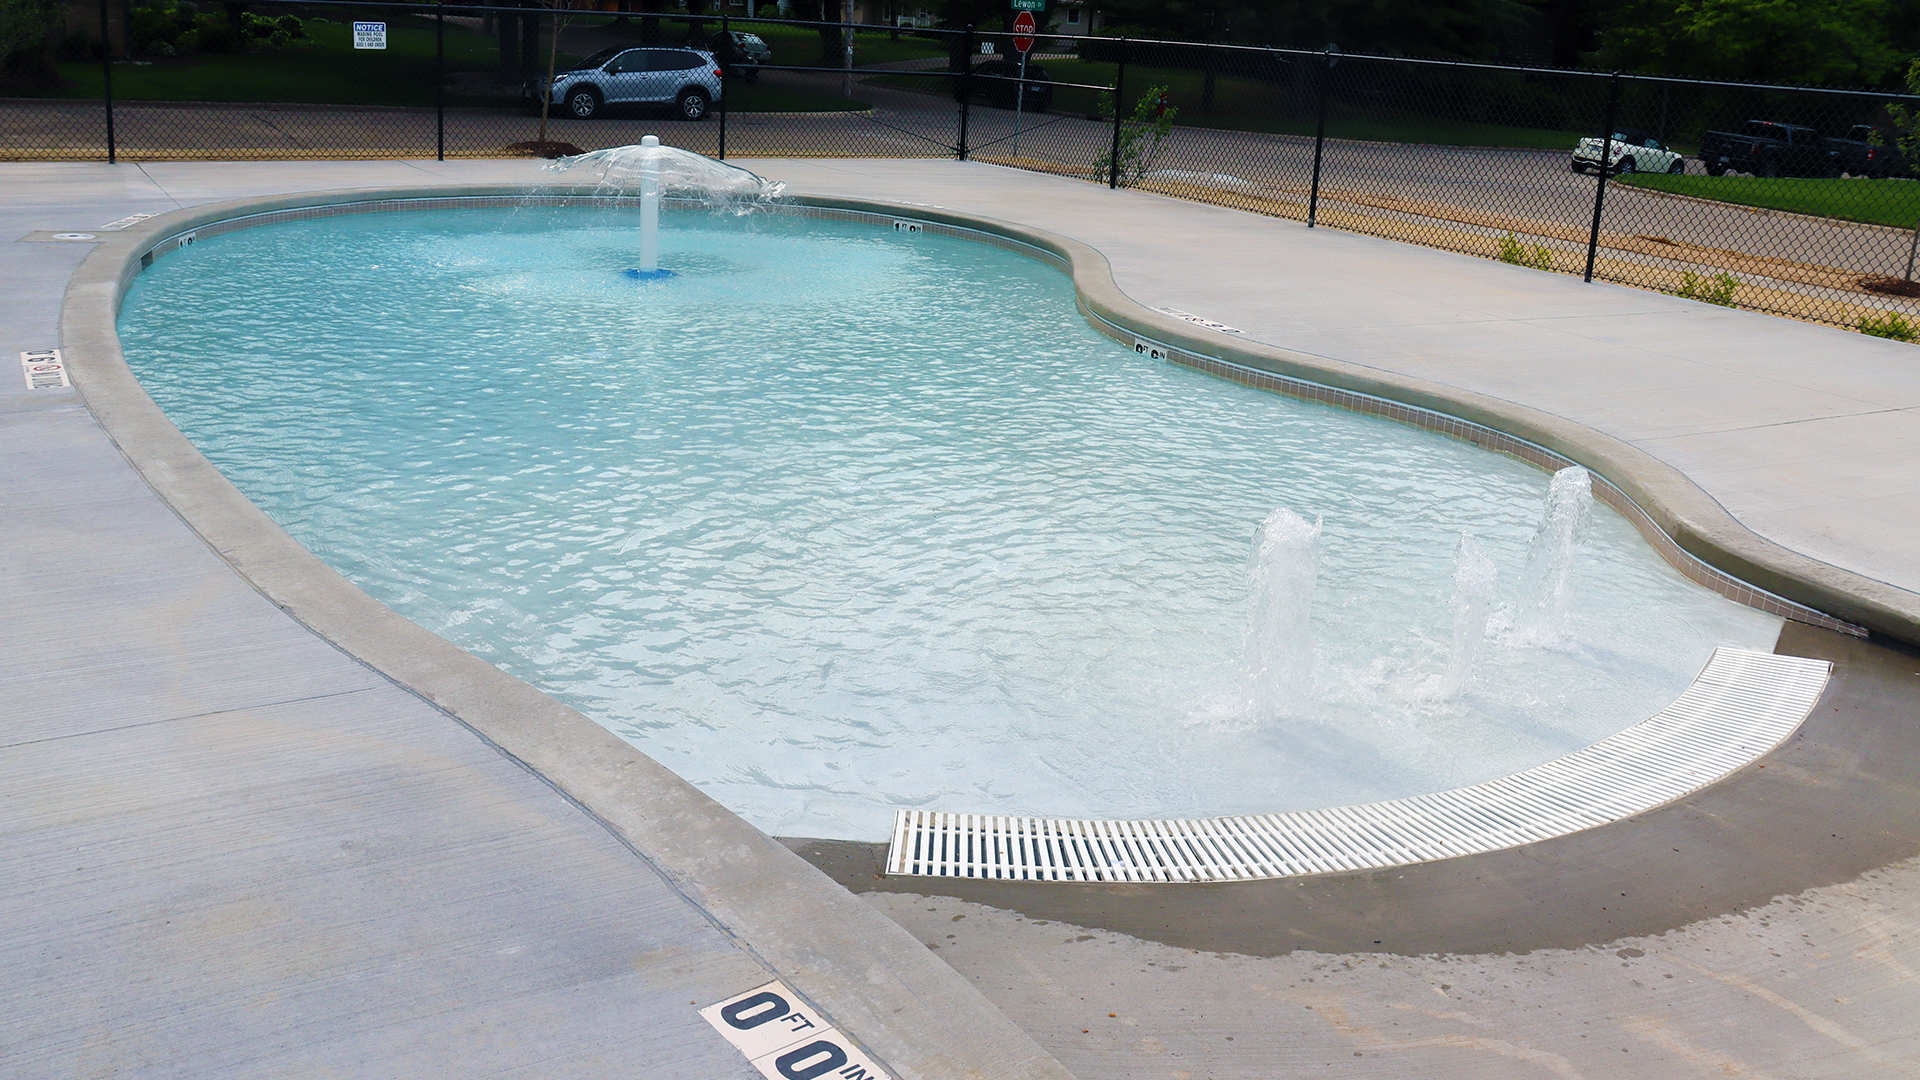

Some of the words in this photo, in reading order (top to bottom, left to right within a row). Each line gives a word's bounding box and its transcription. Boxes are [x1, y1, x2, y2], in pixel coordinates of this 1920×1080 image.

[1014, 0, 1036, 8] Lewon
[1015, 24, 1034, 39] STOP
[721, 992, 790, 1030] 0
[780, 1012, 815, 1032] FT
[775, 1040, 848, 1080] 0
